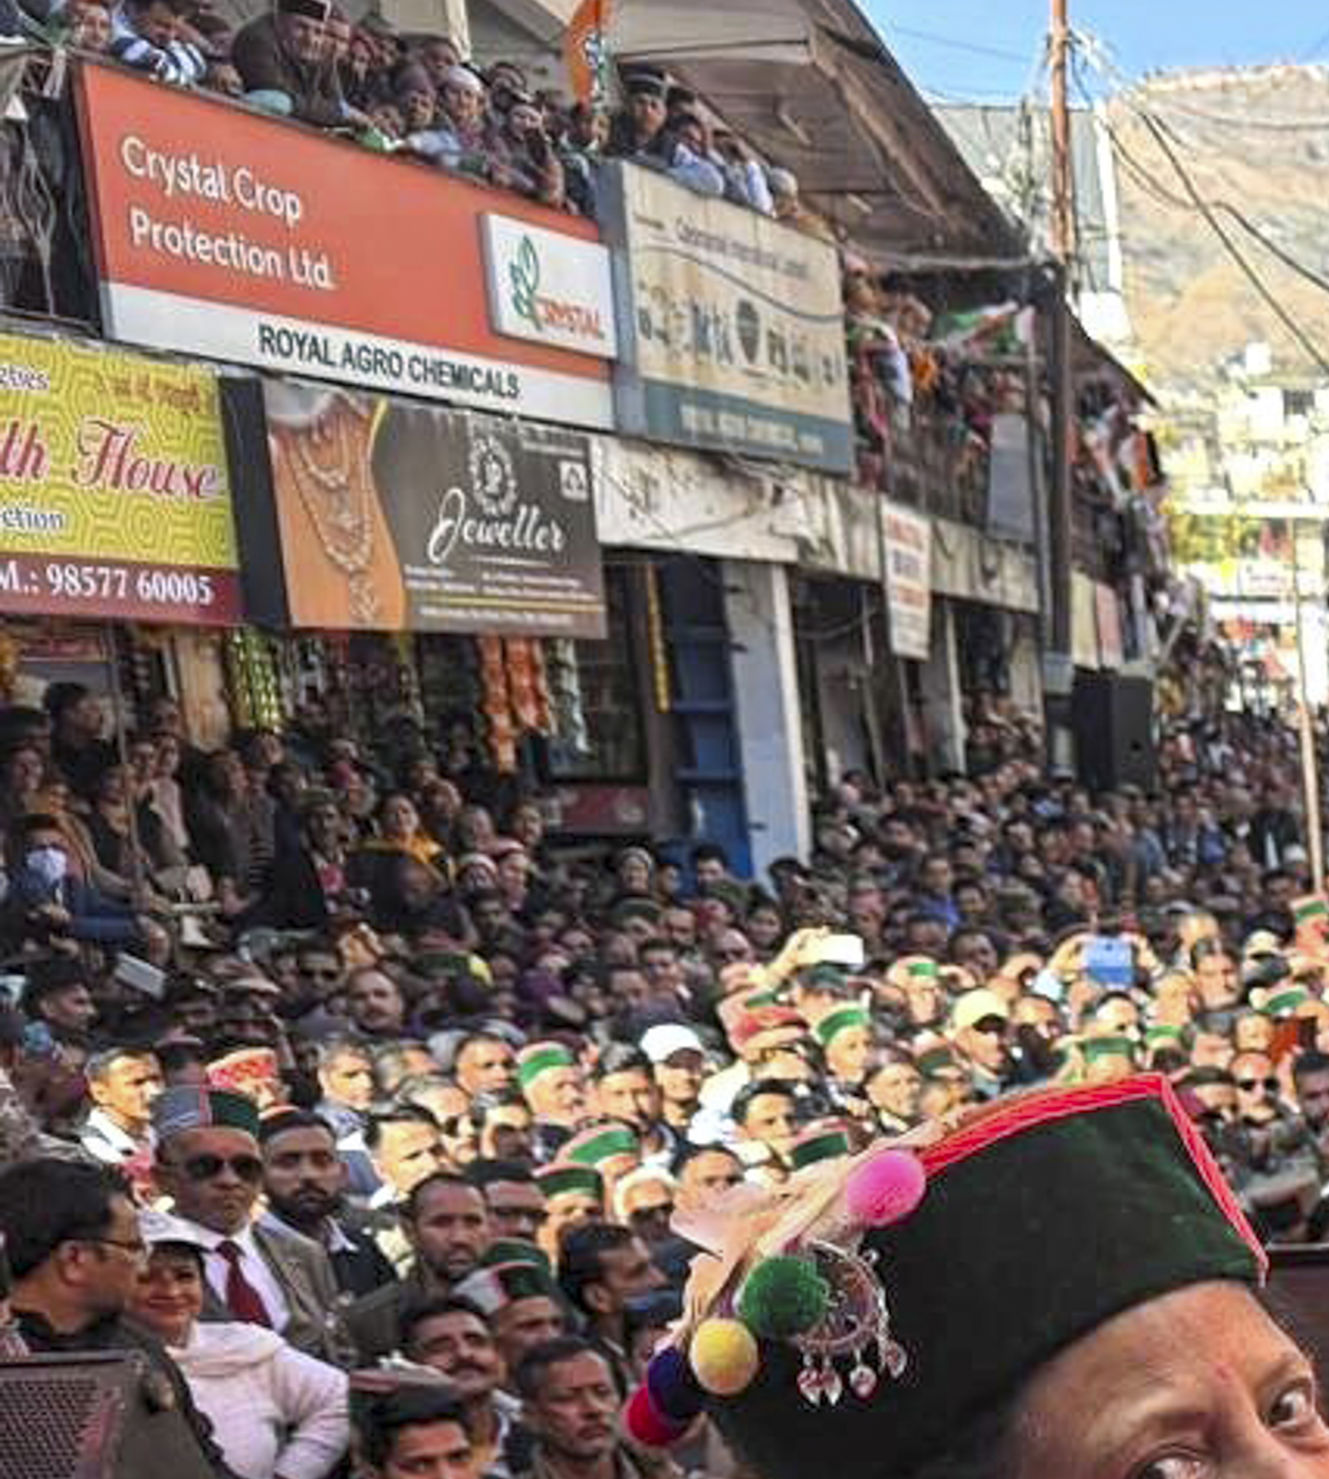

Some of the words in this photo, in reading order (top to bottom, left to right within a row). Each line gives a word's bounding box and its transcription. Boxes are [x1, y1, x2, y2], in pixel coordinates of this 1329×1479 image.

[121, 135, 229, 202] Crystal
[234, 167, 303, 228] Crop
[130, 207, 283, 279] Protection
[258, 323, 336, 368] ROYAL
[341, 344, 404, 378] AGRO
[407, 353, 519, 400] CHEMICALS
[72, 419, 218, 498] House
[427, 486, 566, 564] Jeweller
[46, 563, 129, 599] 98577
[136, 571, 216, 606] 60005
